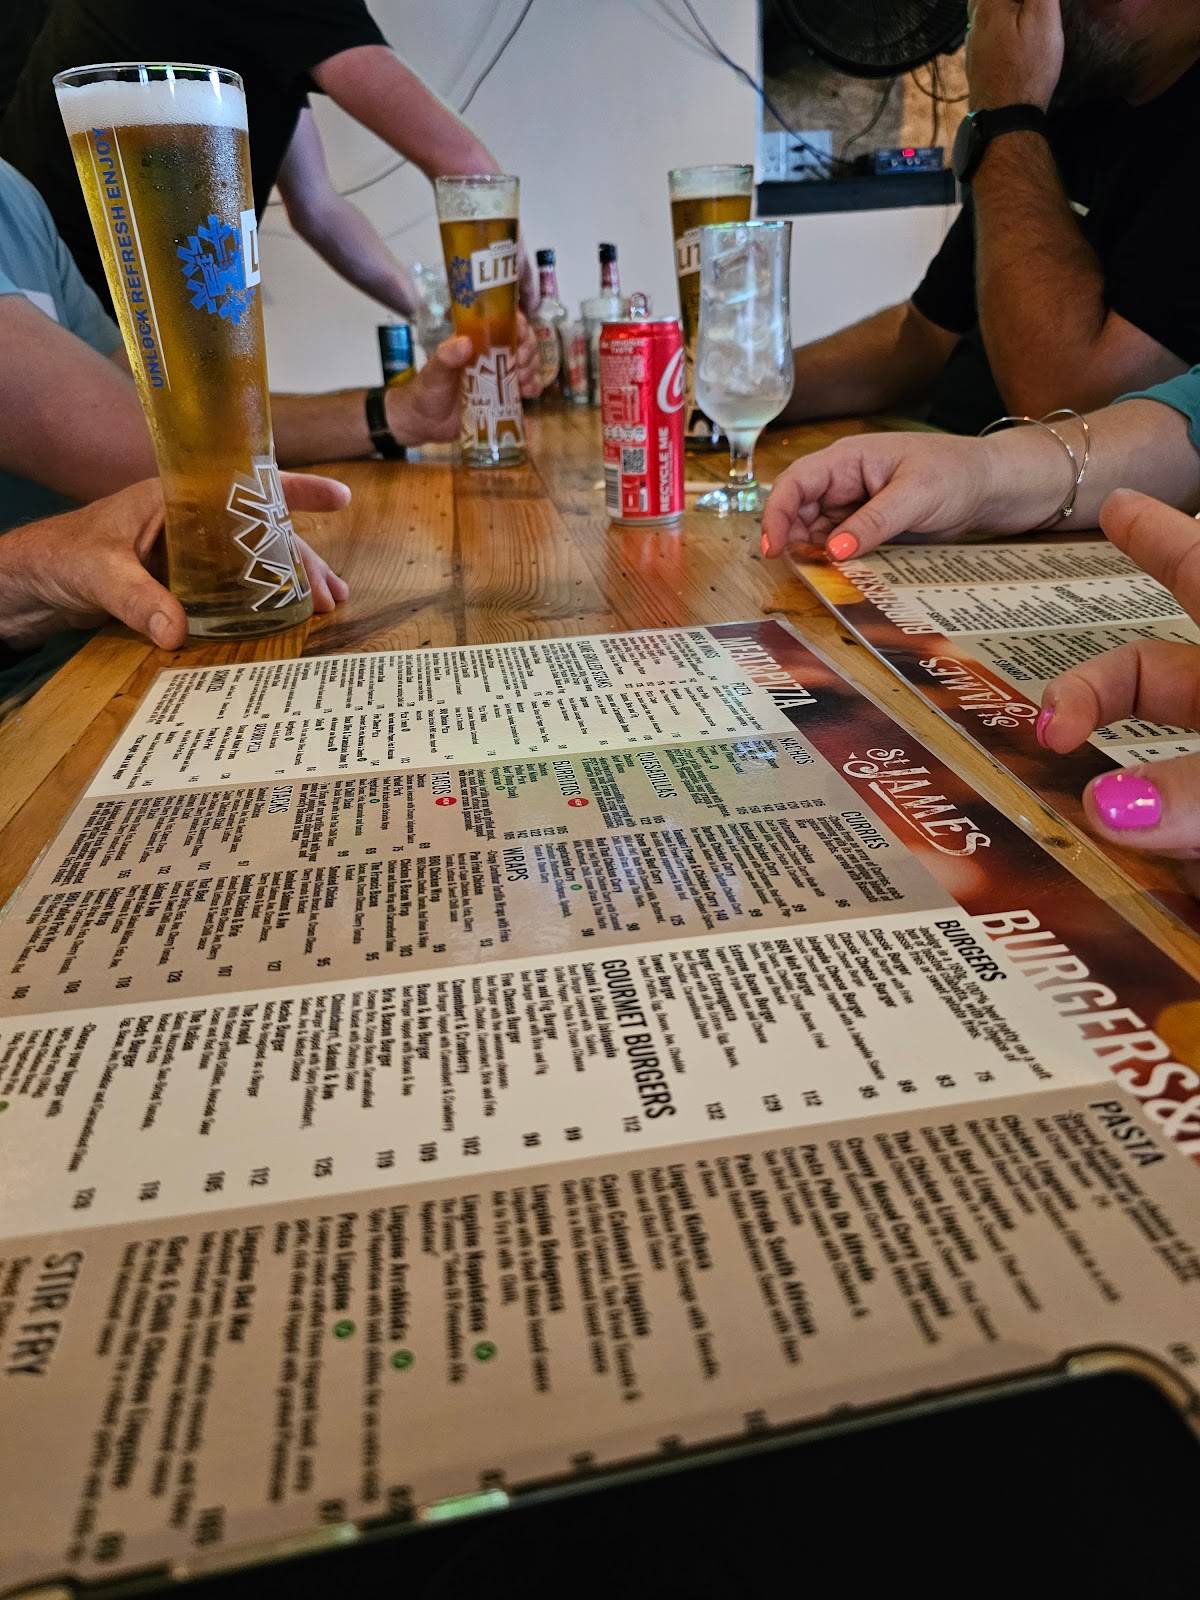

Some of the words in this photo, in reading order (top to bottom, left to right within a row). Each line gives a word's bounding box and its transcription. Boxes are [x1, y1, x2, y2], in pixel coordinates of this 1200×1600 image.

[92, 127, 123, 200] ENJOY
[111, 205, 146, 303] REFRESH
[134, 309, 164, 389] UNLOCK
[658, 427, 670, 449] ME
[659, 452, 670, 513] RECYCLE
[590, 670, 614, 689] STEAKS
[717, 636, 818, 709] MEAT&PIZZA
[919, 656, 1039, 718] JAMES
[777, 737, 815, 765] NACHOS
[866, 748, 911, 768] St
[430, 771, 452, 795] TACOS
[551, 760, 582, 797] BURRITOS
[636, 751, 678, 799] QUESADILLAS
[267, 785, 294, 814] STACKS
[842, 760, 992, 857] JAMES
[633, 832, 647, 848] Green
[776, 817, 801, 844] Vietnamese
[794, 844, 816, 864] Chicken
[840, 811, 890, 850] CURRIES
[427, 855, 442, 867] BBQ
[469, 851, 481, 861] Pan
[640, 846, 655, 858] Thai
[710, 842, 729, 862] Chicken
[721, 862, 737, 877] Curry
[738, 821, 761, 842] Kashmiri
[751, 842, 771, 862] Chicken
[764, 861, 781, 877] Curry
[429, 866, 442, 888] Chicken
[470, 860, 483, 875] Fried
[502, 846, 530, 882] WRAPS
[644, 857, 660, 870] Beef
[649, 869, 664, 885] Curry
[472, 874, 485, 896] Chicken
[681, 848, 697, 865] Prawn
[692, 869, 712, 891] Chicken
[703, 891, 720, 908] Curry
[428, 887, 443, 903] Wrap
[650, 953, 666, 974] Tower
[695, 947, 715, 972] Burger
[869, 928, 893, 951] Classic
[886, 951, 912, 976] Burger
[934, 919, 1007, 982] BURGERS
[501, 972, 514, 987] Five
[534, 968, 548, 984] Brie
[773, 939, 793, 954] BBQ
[792, 971, 816, 997] Burger
[837, 931, 861, 955] Classic
[854, 955, 879, 982] Cheese
[872, 981, 898, 1008] Burger
[381, 987, 396, 1004] Brie
[416, 983, 431, 1007] Bacon
[537, 985, 552, 999] and
[581, 962, 598, 986] Salami
[590, 994, 609, 1021] Grilled
[601, 959, 648, 1028] GOURMET
[657, 975, 676, 1000] Burger
[727, 944, 750, 972] Extreme
[742, 973, 763, 996] Bacon
[754, 996, 777, 1023] Burger
[824, 964, 849, 991] Cheese
[841, 991, 867, 1018] Burger
[241, 1003, 259, 1018] The
[277, 999, 294, 1024] Nacho
[451, 978, 467, 1022] Camembert
[502, 988, 517, 1016] Cheese
[538, 999, 554, 1012] Fig
[189, 1008, 208, 1024] The
[380, 1012, 396, 1038] Bacon
[505, 1016, 521, 1044] Burger
[542, 1012, 558, 1040] Burger
[181, 1024, 202, 1052] Italian
[235, 1019, 255, 1046] Arnold
[270, 1024, 291, 1052] Burger
[415, 1031, 433, 1060] Burger
[376, 1038, 395, 1067] Burger
[455, 1031, 470, 1074] Cranberry
[623, 1032, 677, 1119] BURGERS
[1089, 1100, 1165, 1167] PASTA
[29, 1251, 84, 1313] STIR
